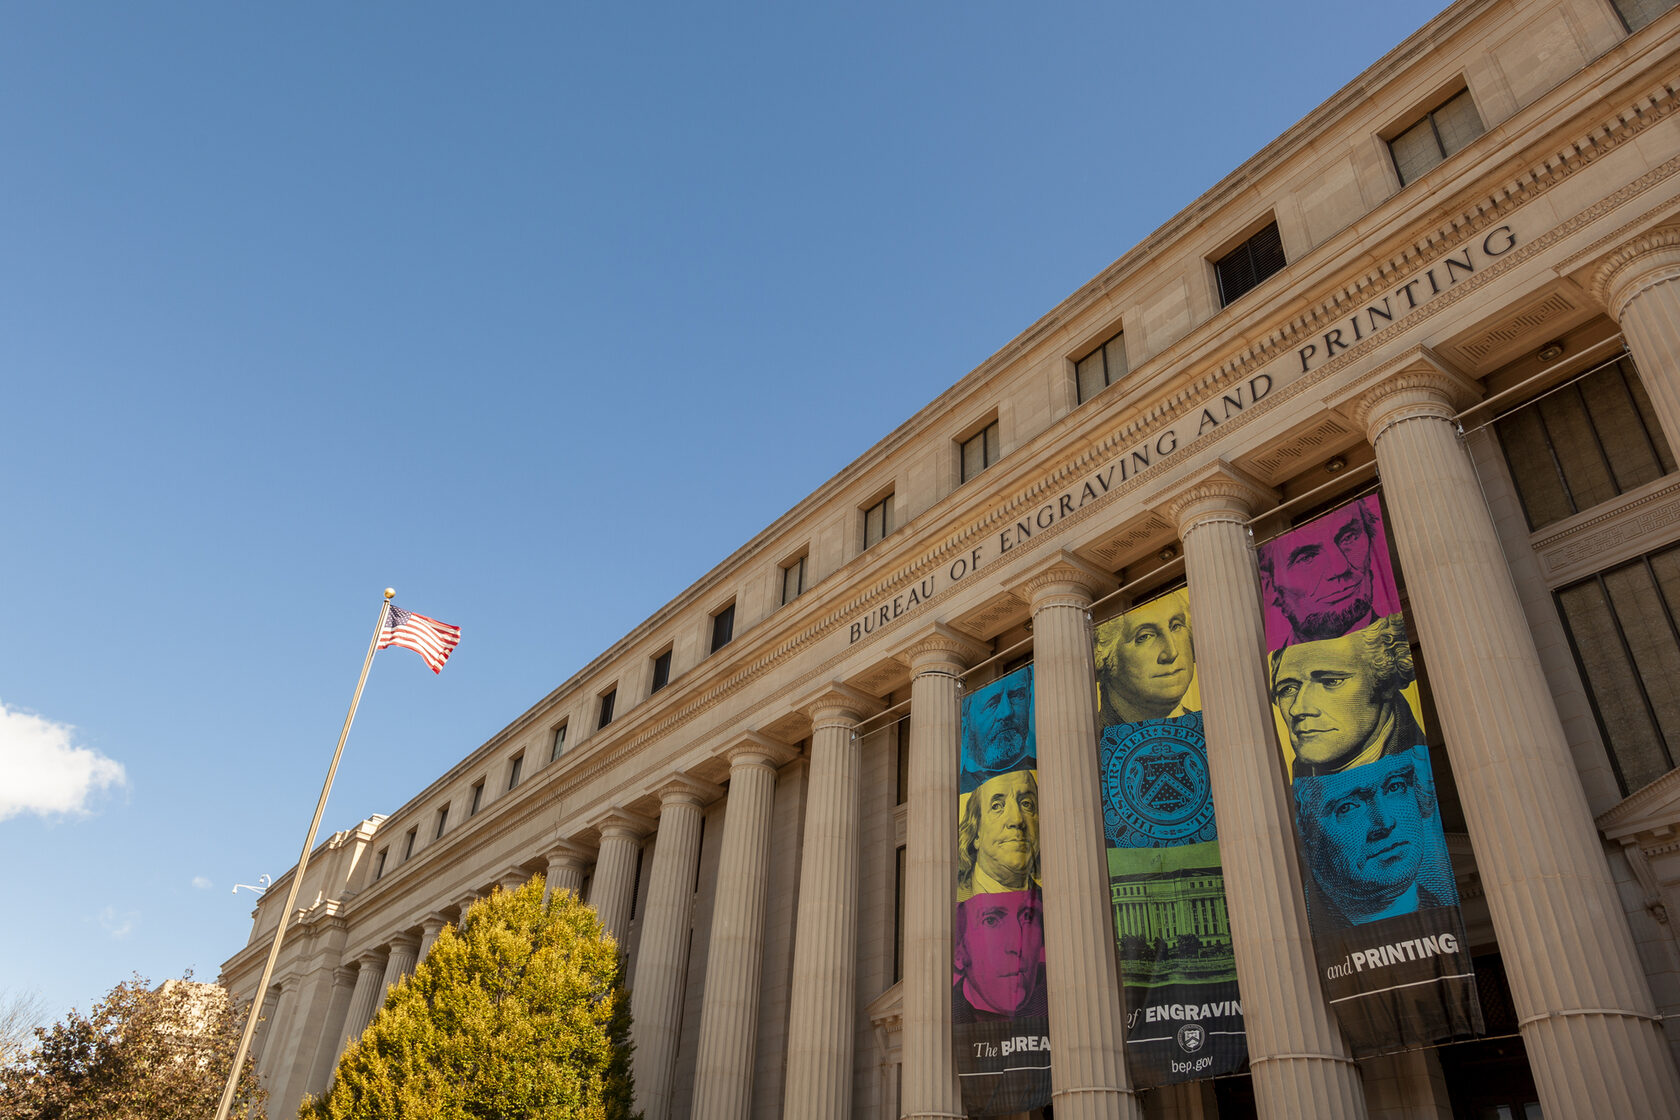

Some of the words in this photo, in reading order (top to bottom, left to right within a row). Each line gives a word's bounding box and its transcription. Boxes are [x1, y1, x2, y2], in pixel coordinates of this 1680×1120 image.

[850, 575, 936, 644] BUREAU
[949, 546, 983, 581] OF
[999, 430, 1178, 553] ENGRAVING
[1197, 373, 1272, 436] AND
[1298, 225, 1516, 373] PRINTING
[1327, 956, 1354, 980] and
[1351, 933, 1460, 973] PRINTING
[1145, 1000, 1244, 1023] ENGRAVIN
[973, 1042, 998, 1058] The
[1001, 1036, 1051, 1057] BUREA
[1171, 1056, 1214, 1074] bep.gov
